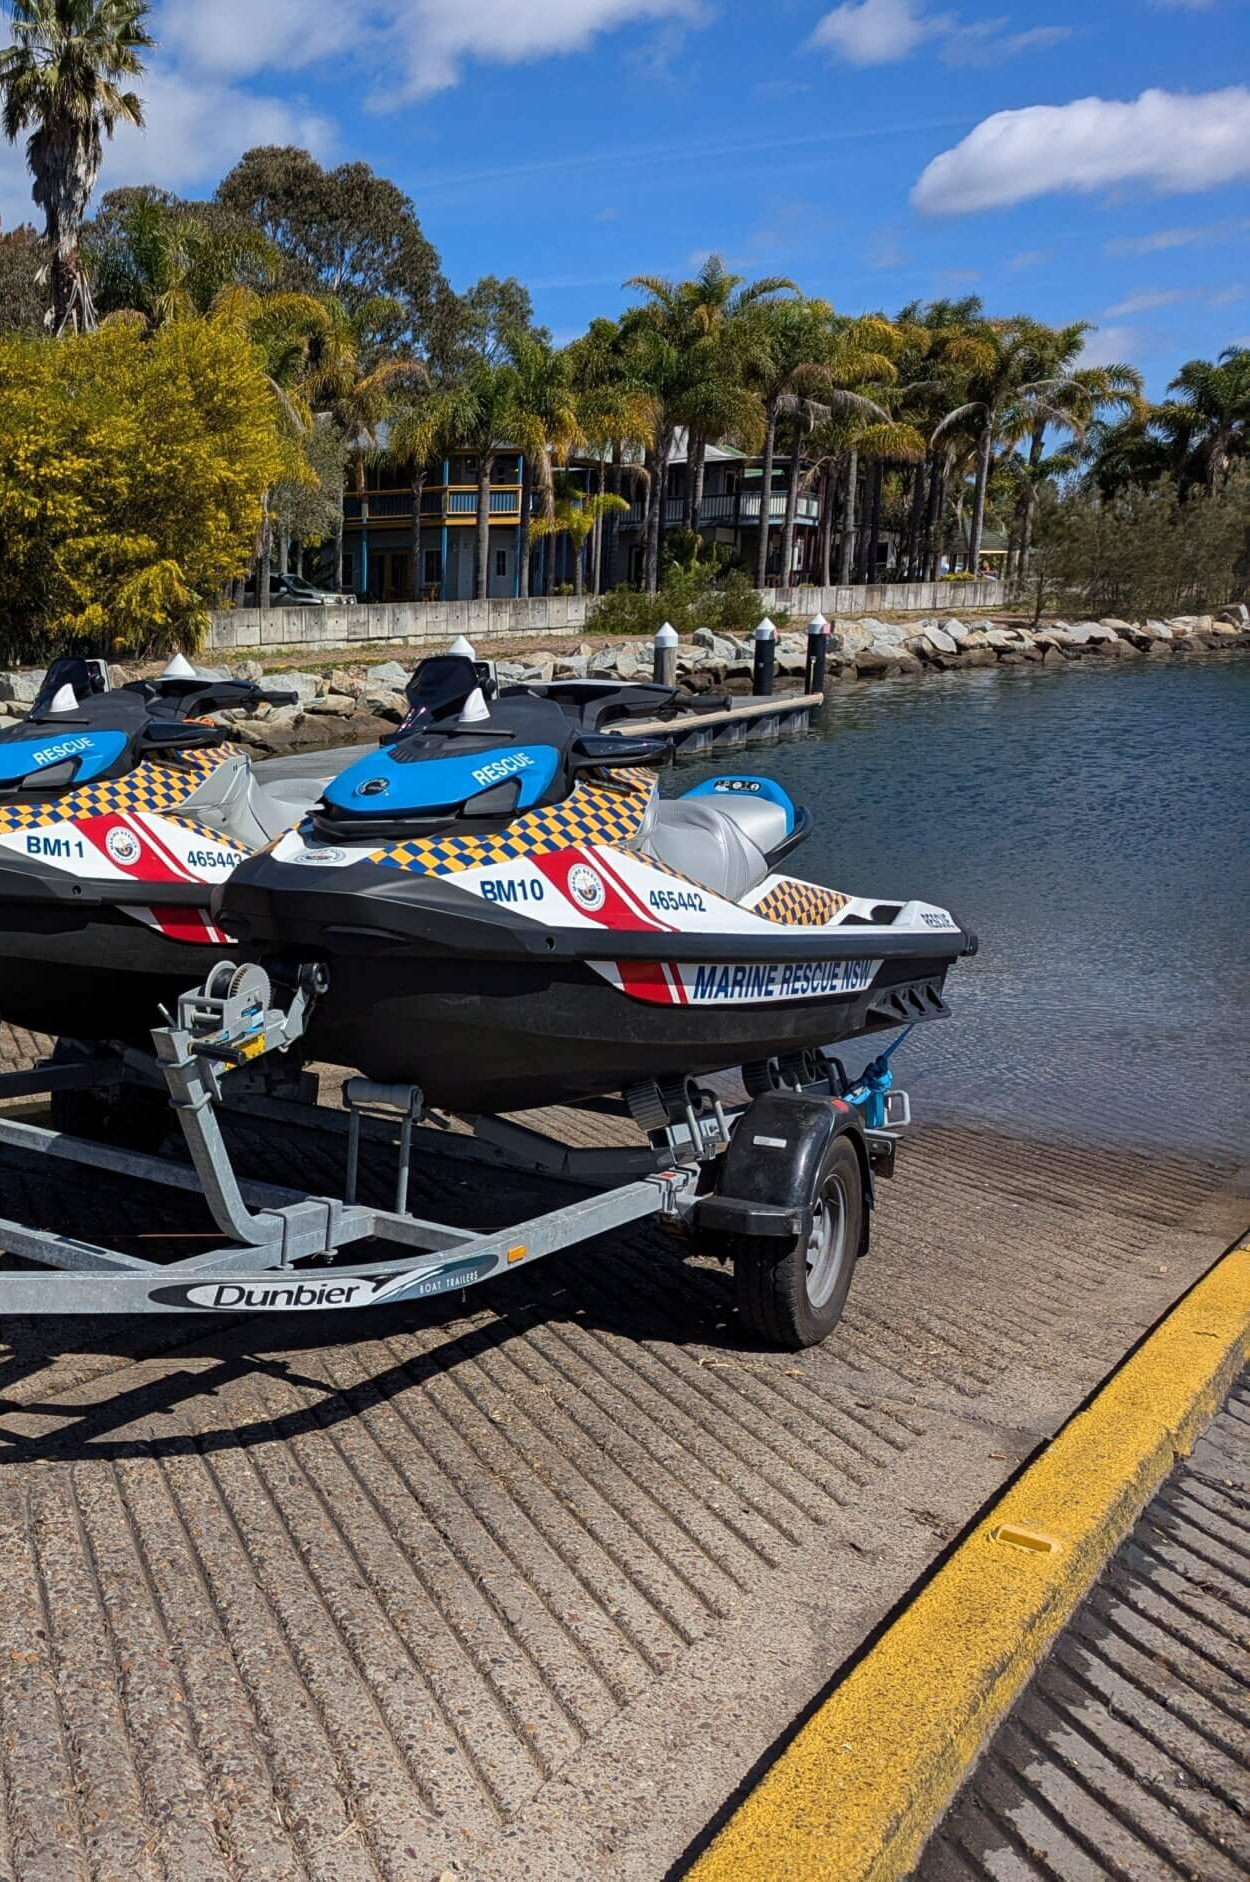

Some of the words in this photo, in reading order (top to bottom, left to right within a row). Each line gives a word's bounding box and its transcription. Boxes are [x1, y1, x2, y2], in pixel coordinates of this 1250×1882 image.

[33, 736, 94, 766] RESCUE
[473, 752, 534, 787] RESCUE
[26, 835, 84, 858] BM11
[480, 879, 544, 903] BM10
[649, 890, 707, 912] 465442
[693, 964, 777, 1000] MARINE
[779, 961, 840, 996] RESCUE
[841, 960, 872, 991] NSW
[213, 1284, 360, 1307] Dunbier
[419, 1281, 442, 1294] BOAT
[446, 1270, 479, 1290] TRAILERS
